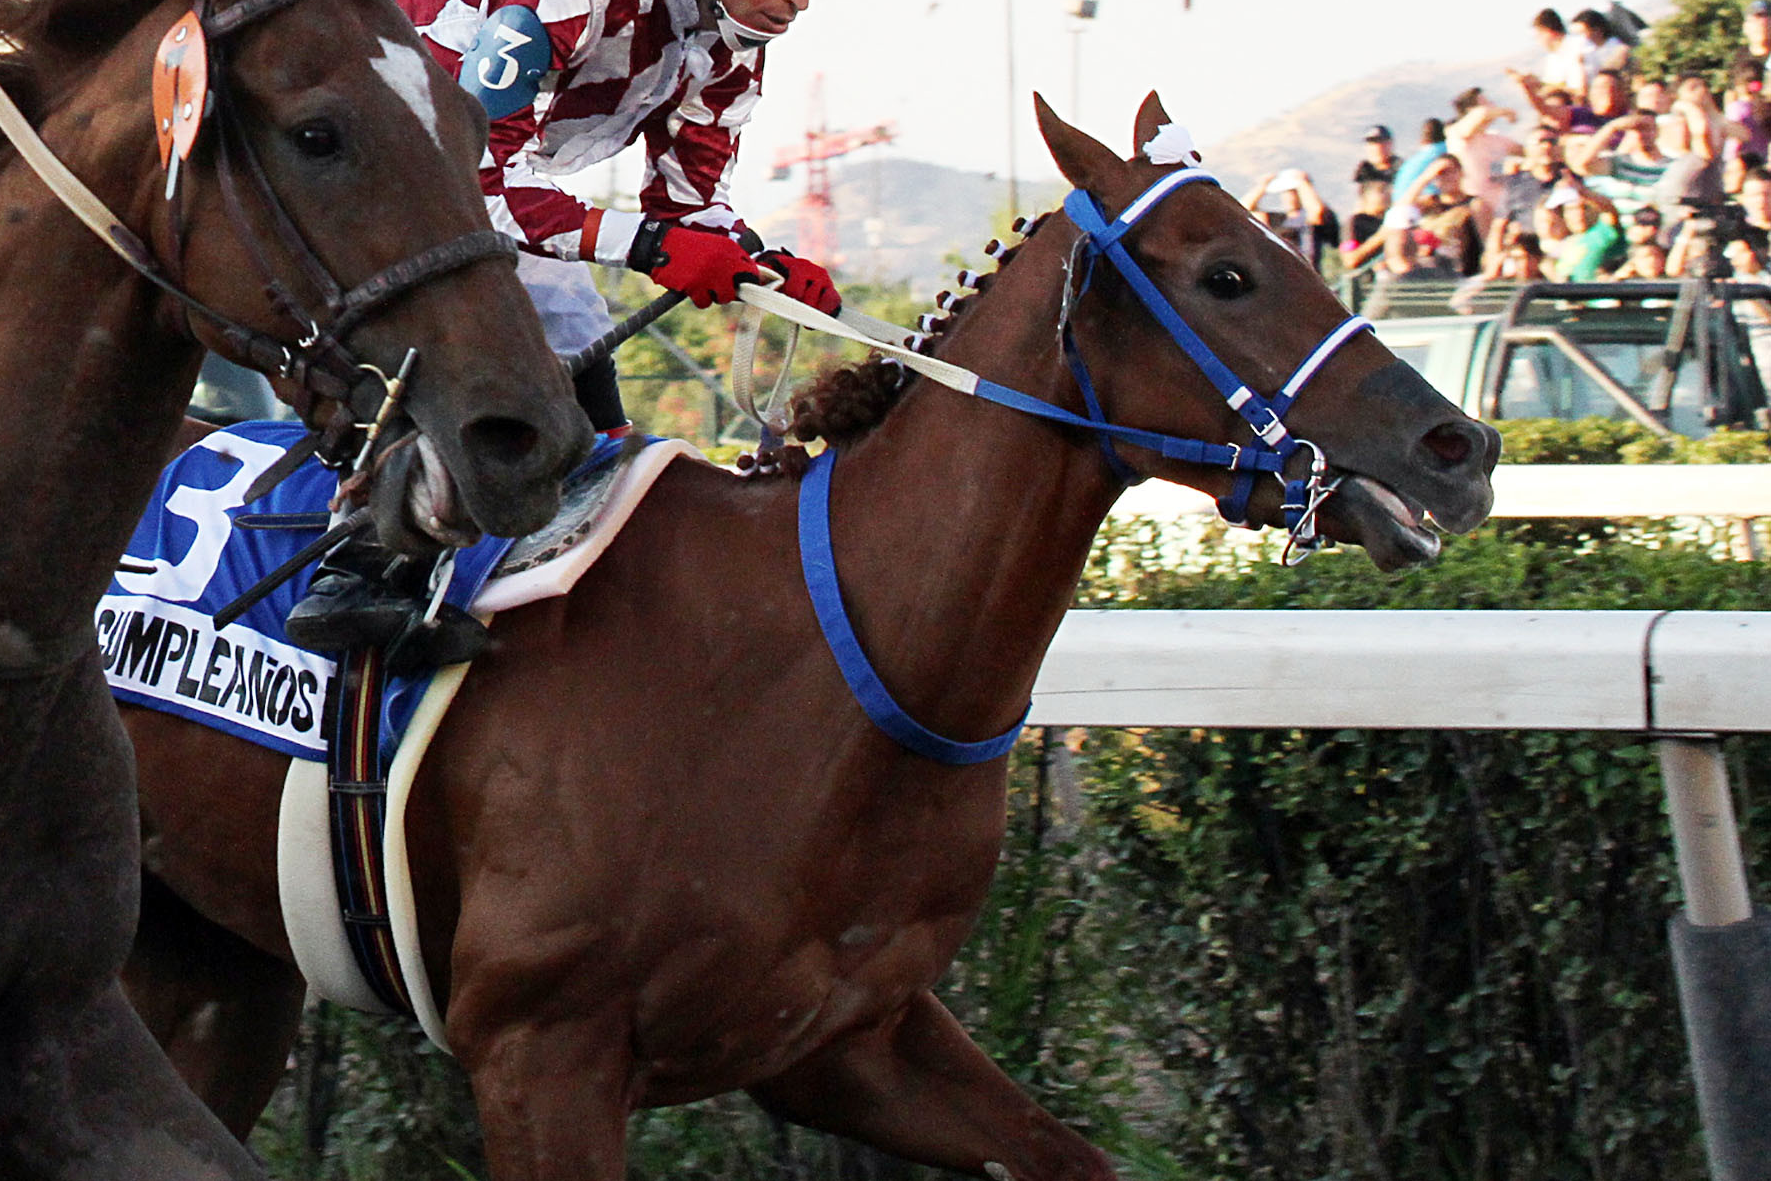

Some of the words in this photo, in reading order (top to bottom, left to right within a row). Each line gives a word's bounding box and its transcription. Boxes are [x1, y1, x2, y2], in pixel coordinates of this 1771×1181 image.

[477, 23, 533, 91] 3
[114, 431, 287, 602] 3
[96, 608, 319, 733] CUMPLEAÑOS
